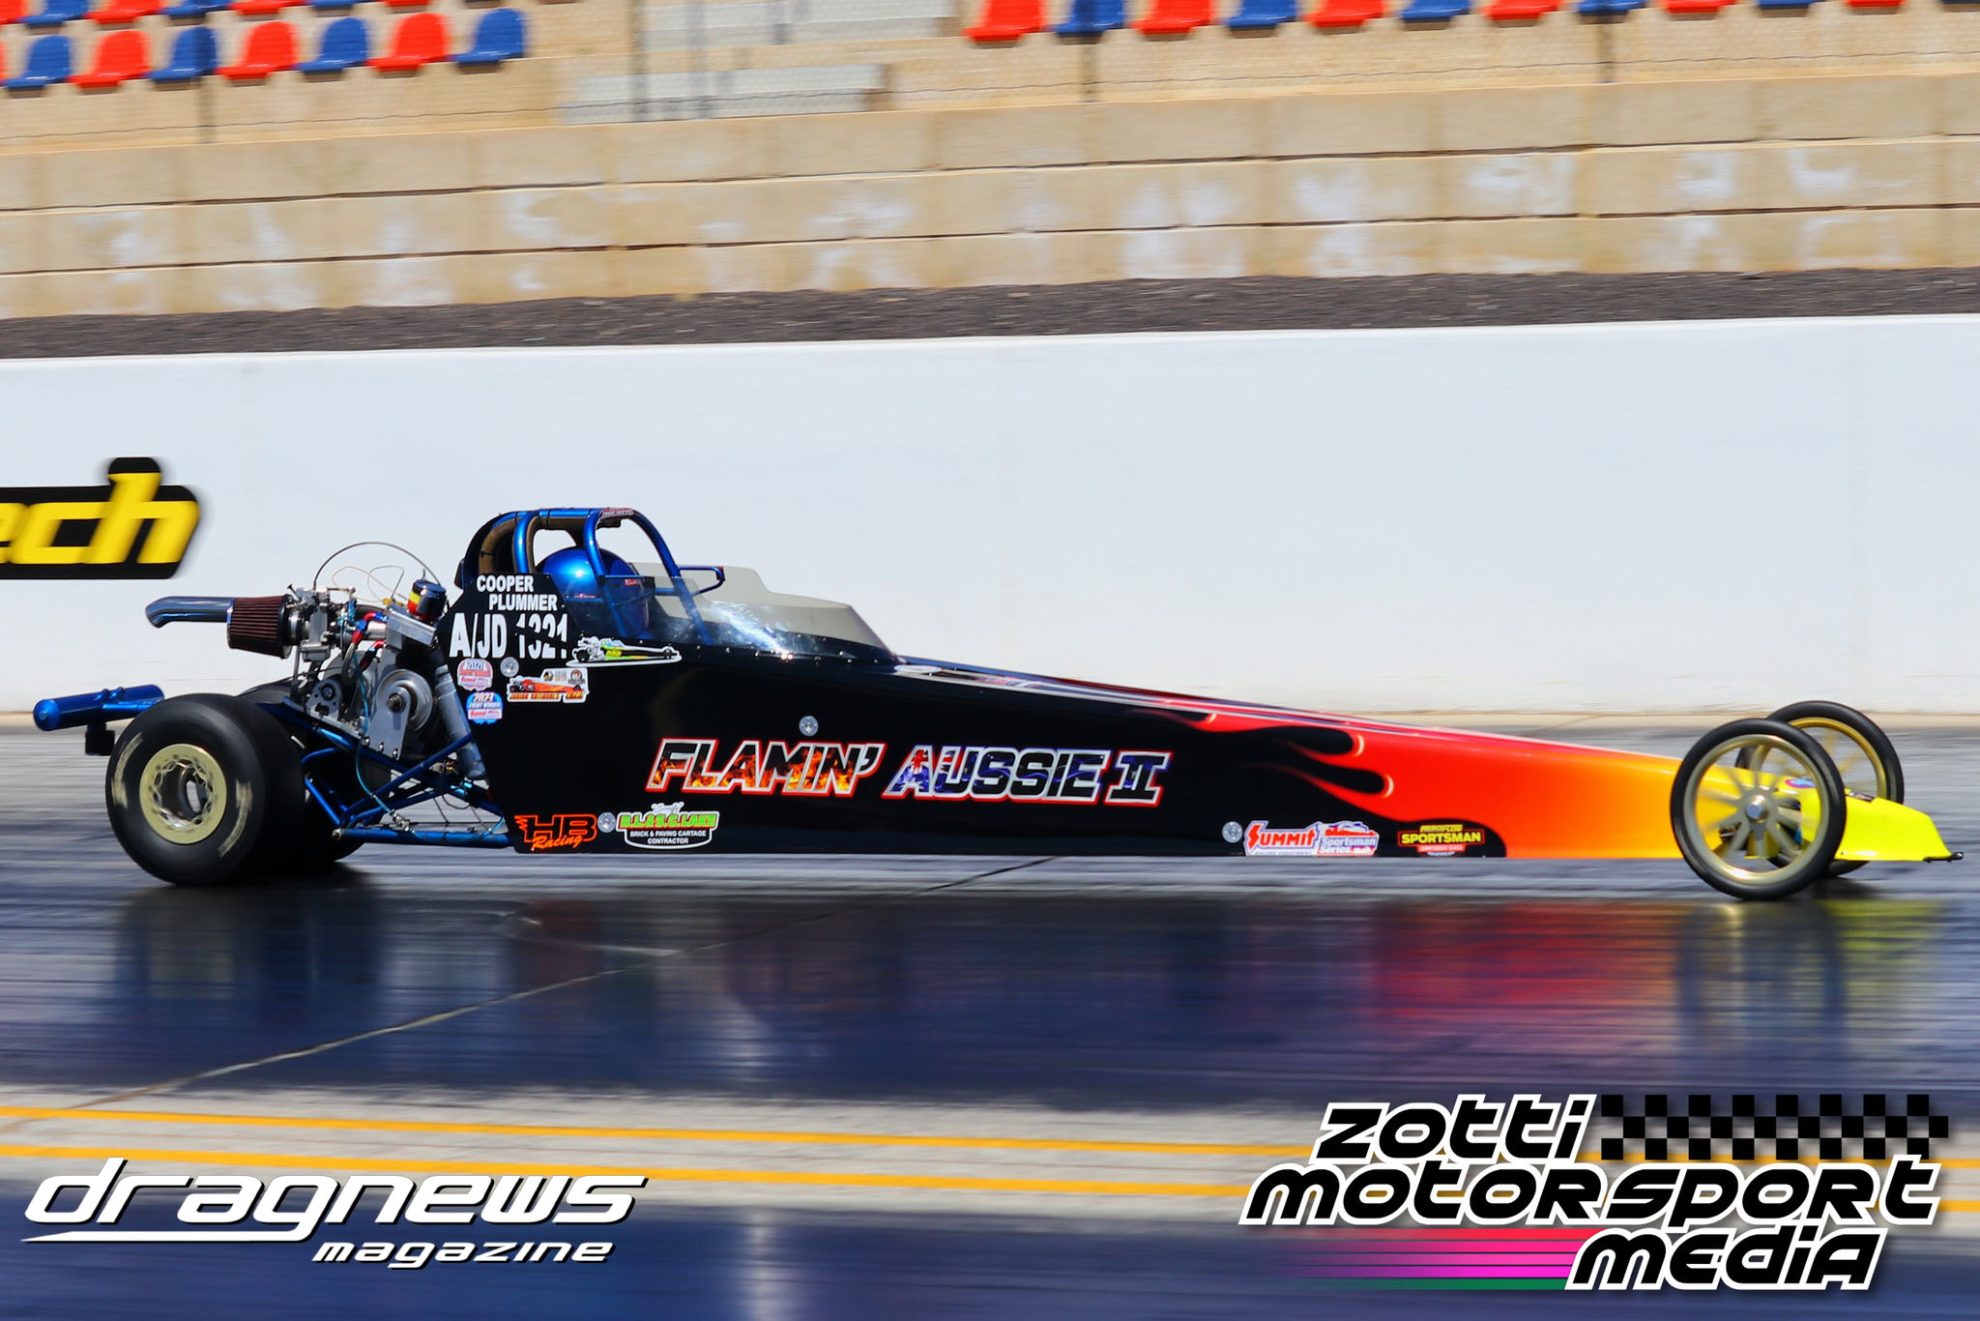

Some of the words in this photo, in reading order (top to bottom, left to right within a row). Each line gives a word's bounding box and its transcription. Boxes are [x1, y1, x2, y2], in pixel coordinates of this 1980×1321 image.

[476, 575, 535, 592] COOPER
[489, 593, 558, 611] PLUMMER
[449, 612, 508, 659] A/JD
[515, 613, 568, 660] 1321
[646, 738, 887, 797] FLAMIN'
[882, 744, 1113, 803] AUSSIE
[1104, 750, 1173, 806] II
[514, 814, 598, 843] HB
[531, 833, 584, 850] Racing
[647, 837, 689, 845] CONTRACTOR
[1401, 832, 1481, 844] SPORTSMAN
